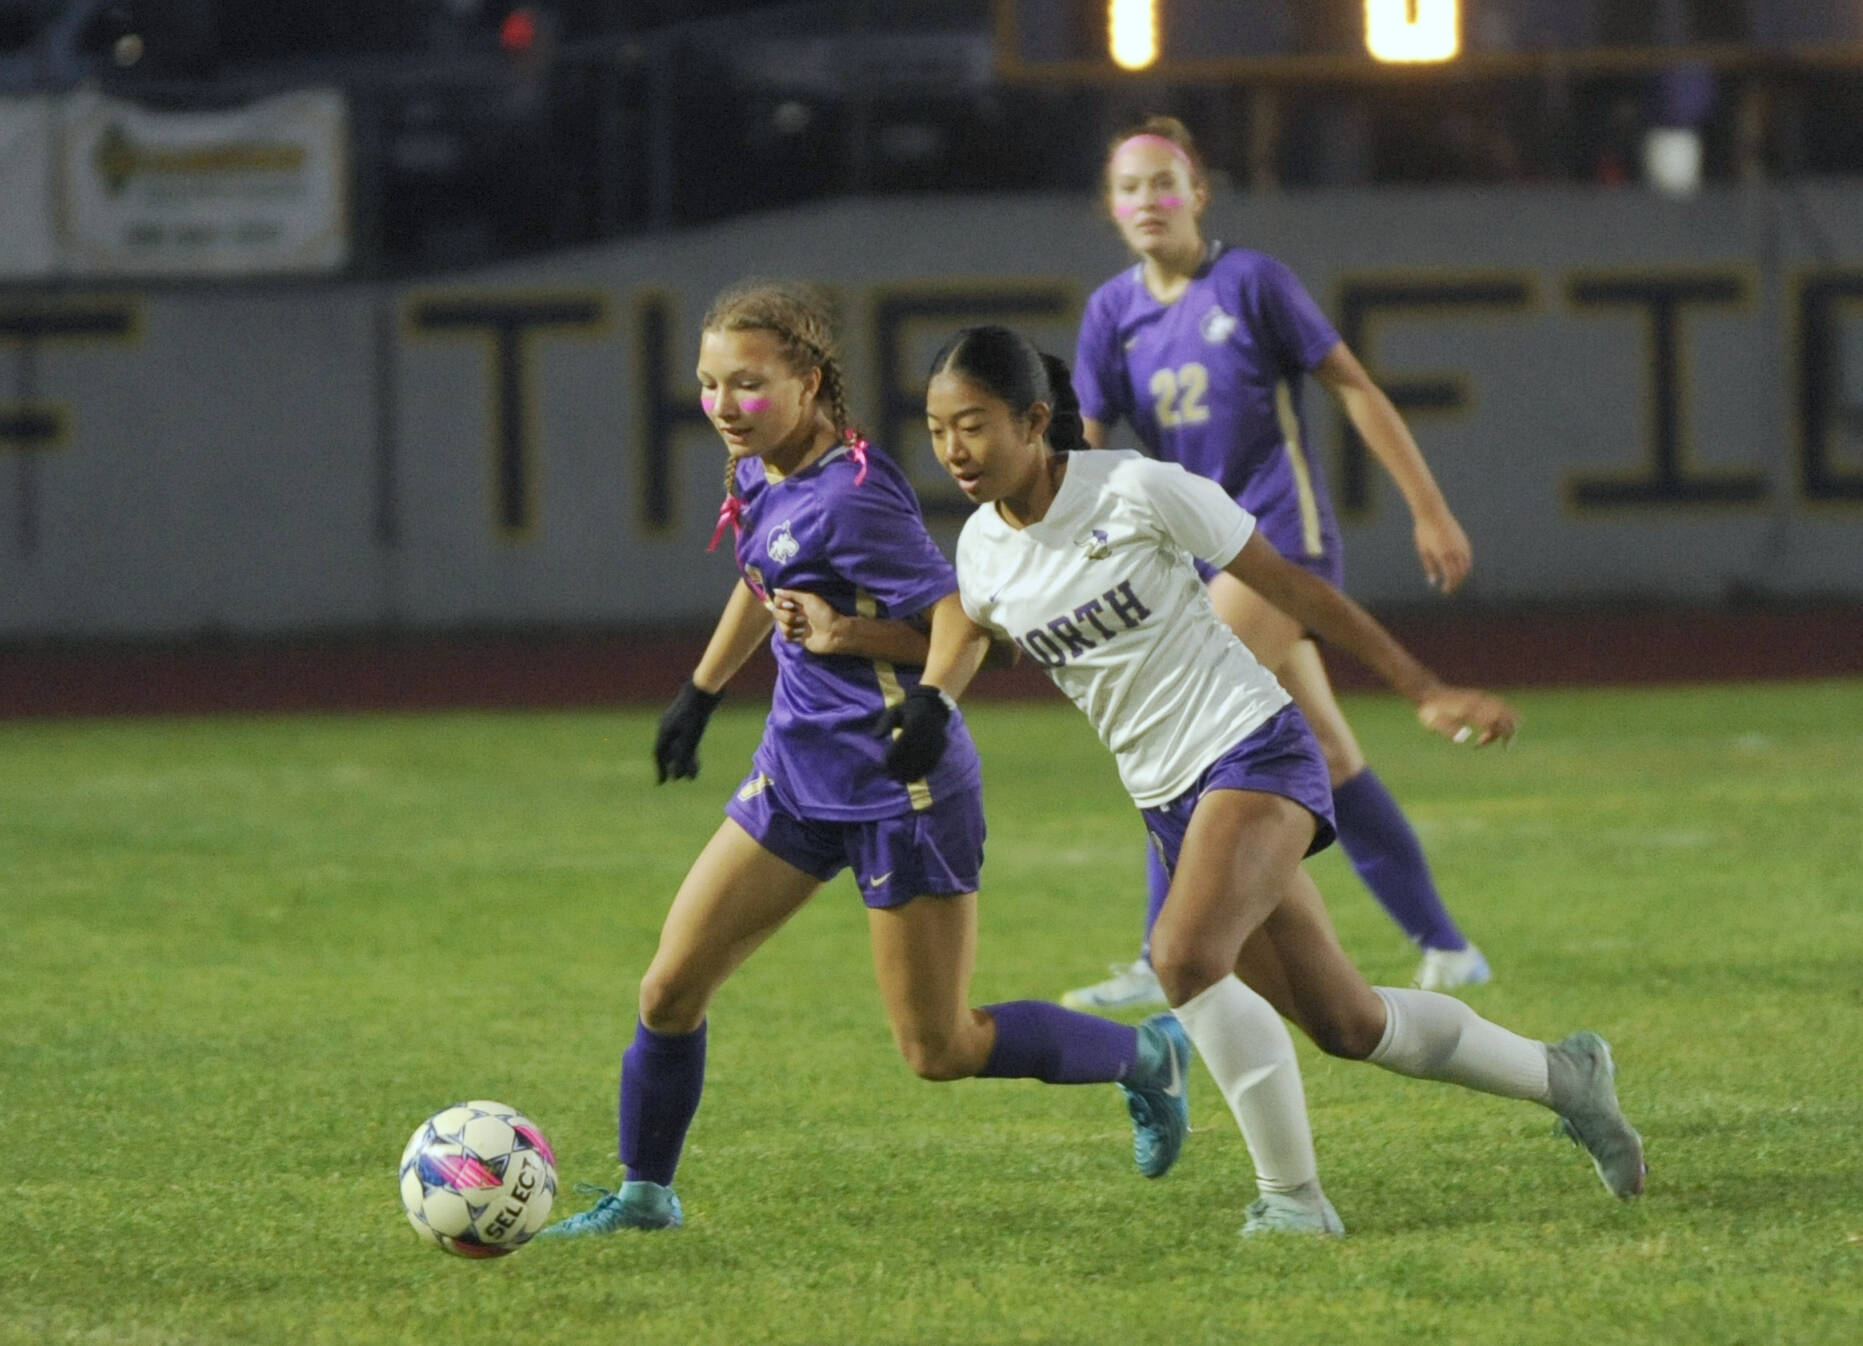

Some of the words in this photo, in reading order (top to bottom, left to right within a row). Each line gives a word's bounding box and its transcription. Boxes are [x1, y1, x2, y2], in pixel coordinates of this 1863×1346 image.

[1150, 362, 1210, 428] 22
[1015, 579, 1152, 668] ORTH
[485, 1157, 537, 1239] SELECT
